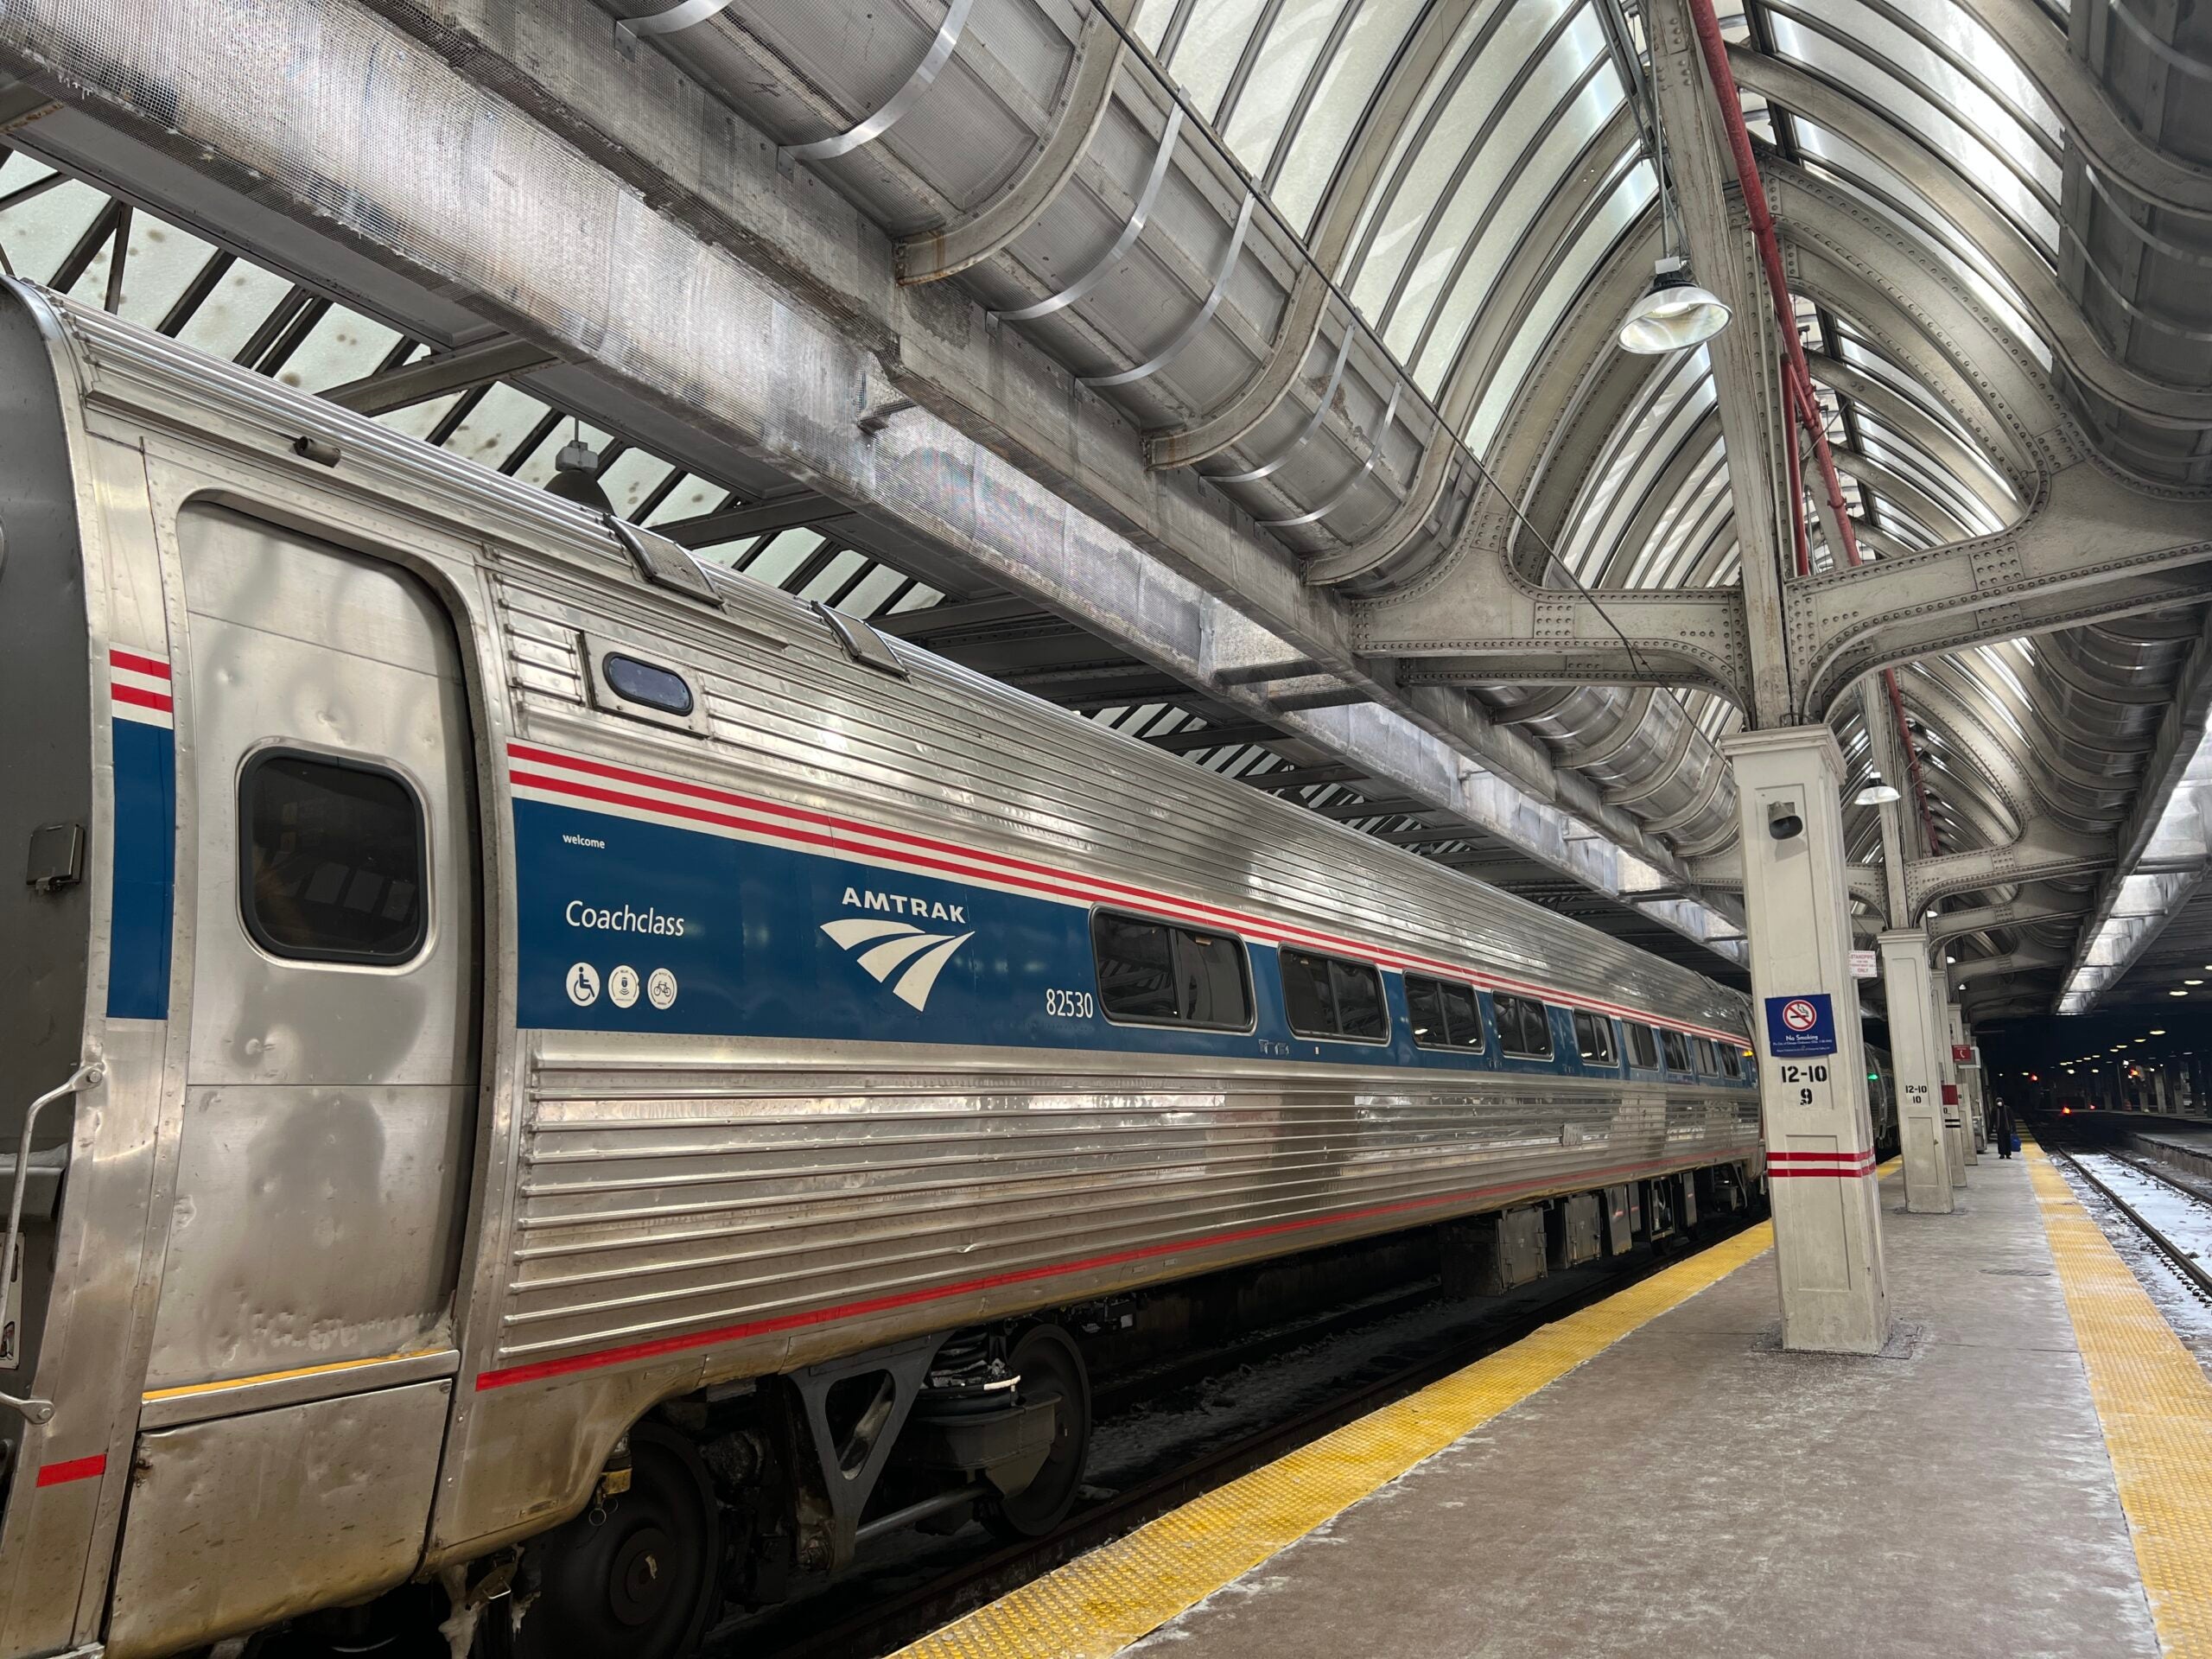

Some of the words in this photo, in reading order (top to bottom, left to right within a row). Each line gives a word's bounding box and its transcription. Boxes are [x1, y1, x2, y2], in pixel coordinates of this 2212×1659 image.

[563, 834, 605, 849] welcome
[842, 887, 966, 924] AMTRAK
[565, 900, 684, 937] Coachclass
[1046, 988, 1094, 1019] 82530
[1781, 1065, 1827, 1083] 12-10
[1800, 1088, 1813, 1105] 9
[1905, 1084, 1928, 1094] 12-10
[1912, 1095, 1922, 1104] 10
